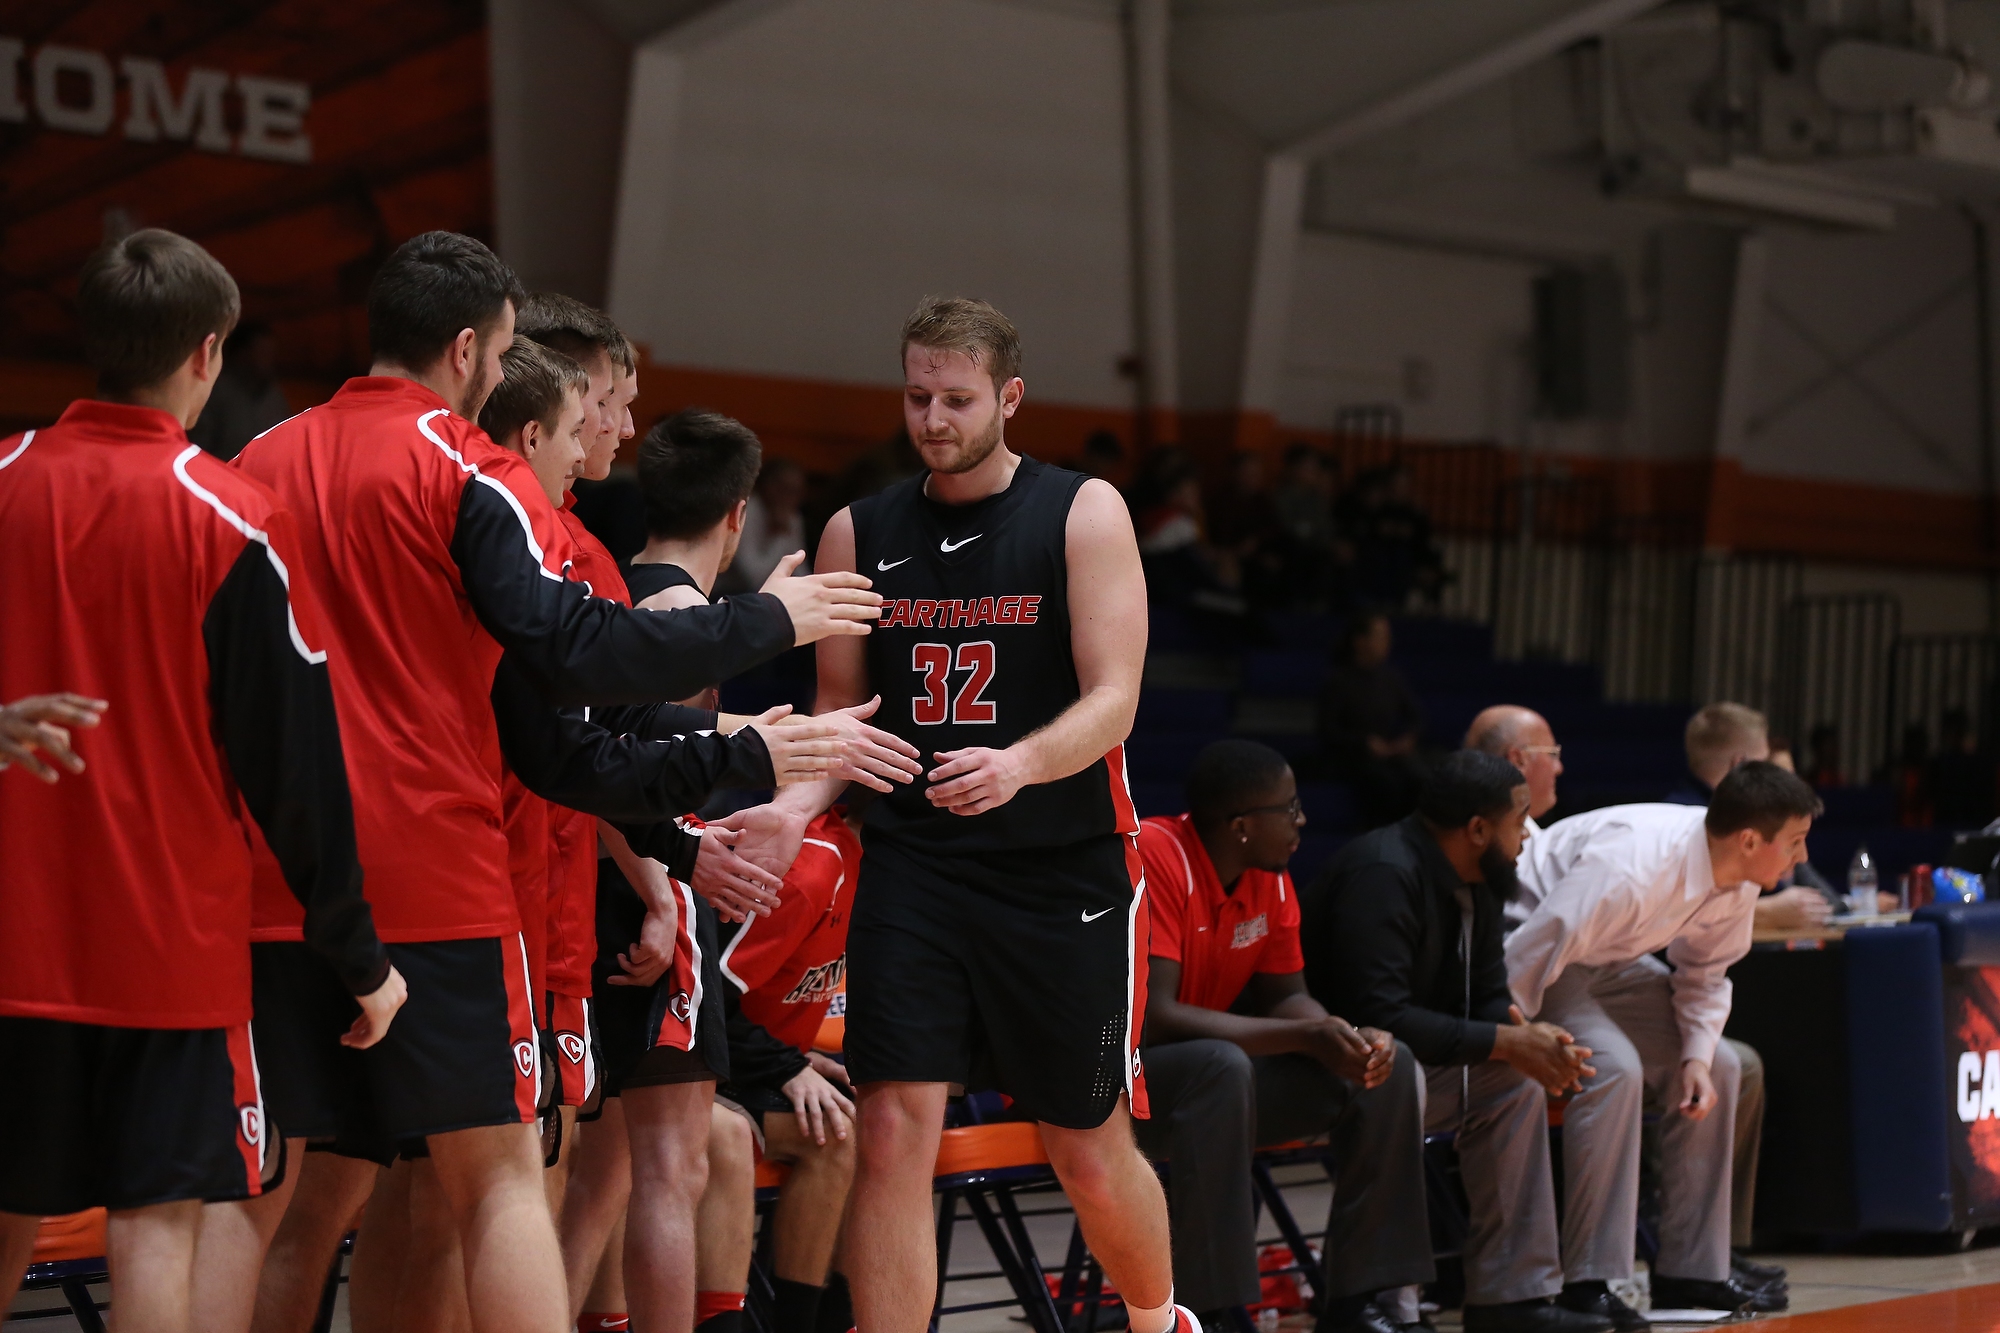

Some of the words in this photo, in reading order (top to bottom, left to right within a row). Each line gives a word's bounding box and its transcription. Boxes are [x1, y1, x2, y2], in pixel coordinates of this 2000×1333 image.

[0, 36, 310, 163] OME
[877, 595, 1043, 629] CARTHAGE
[912, 640, 997, 726] 32
[519, 1045, 531, 1072] C
[565, 1036, 581, 1060] C
[1957, 1049, 2000, 1122] CA
